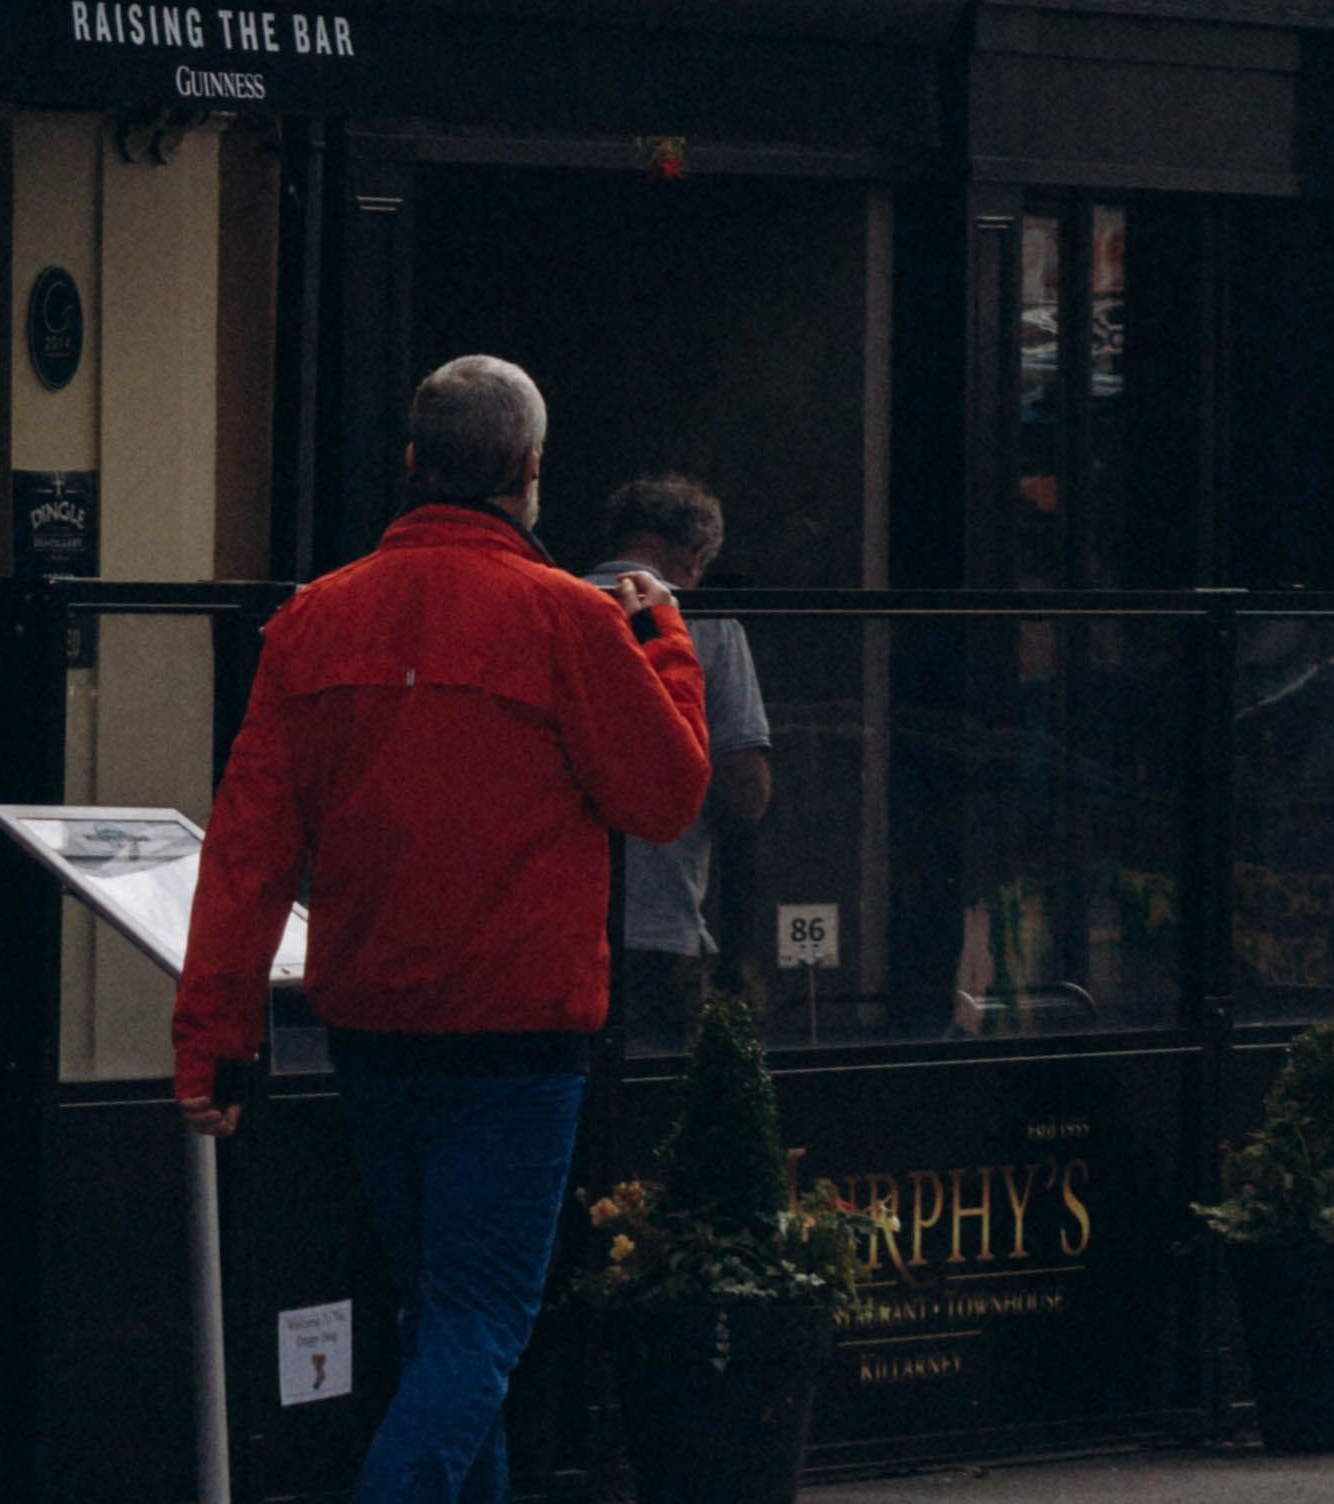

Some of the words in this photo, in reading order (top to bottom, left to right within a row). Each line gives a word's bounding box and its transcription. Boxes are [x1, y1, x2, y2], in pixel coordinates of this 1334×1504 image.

[71, 0, 205, 49] RAISING
[218, 9, 281, 53] THE
[292, 13, 356, 57] BAR
[30, 500, 87, 531] DINGLE
[790, 917, 826, 943] 86
